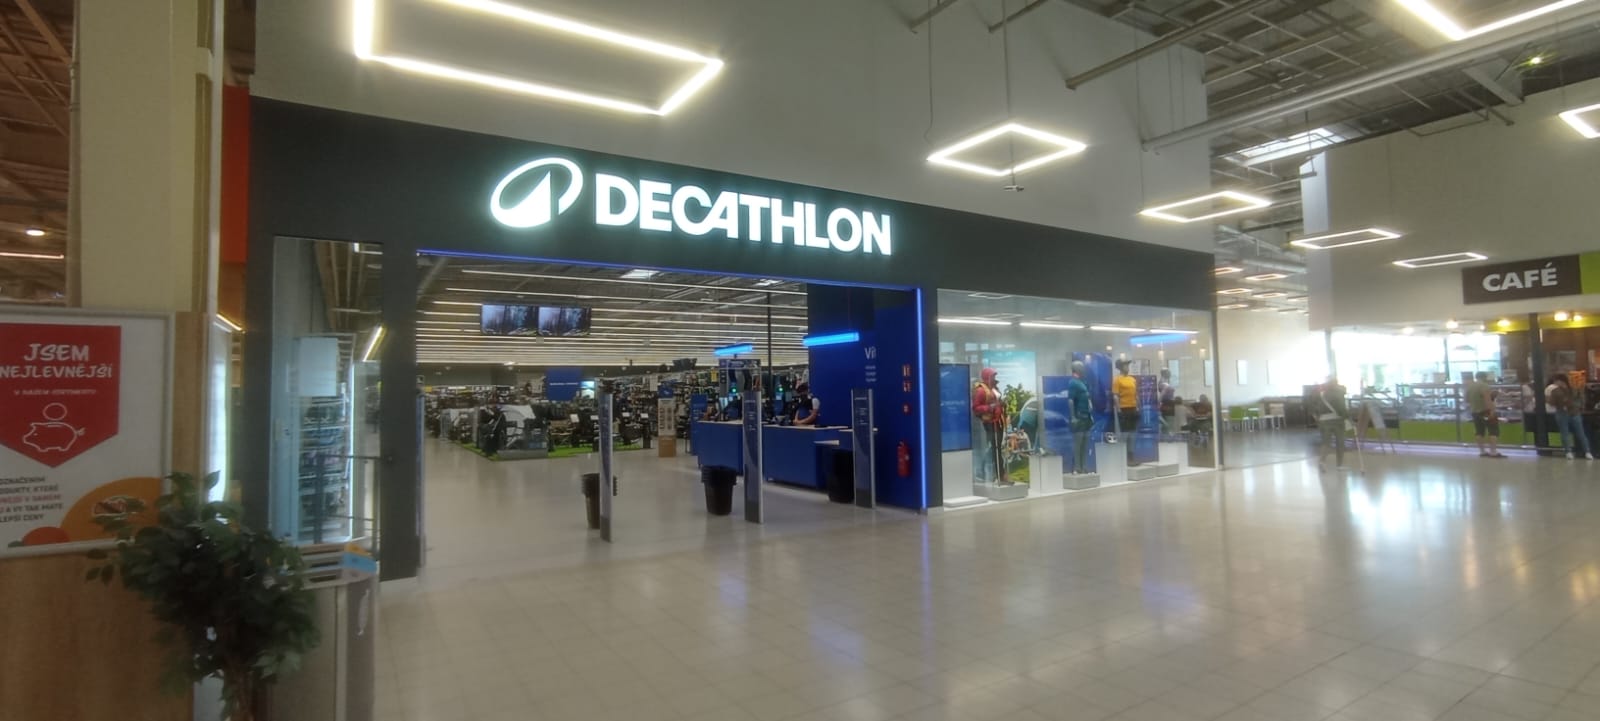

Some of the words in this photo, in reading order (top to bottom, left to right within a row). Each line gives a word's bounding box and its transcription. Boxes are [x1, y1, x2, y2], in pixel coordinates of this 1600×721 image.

[595, 173, 892, 256] DECATHLON
[1482, 262, 1558, 292] CAFÉ
[24, 343, 90, 362] JSEM
[0, 363, 113, 379] NEJLEVNĚJŠÍ
